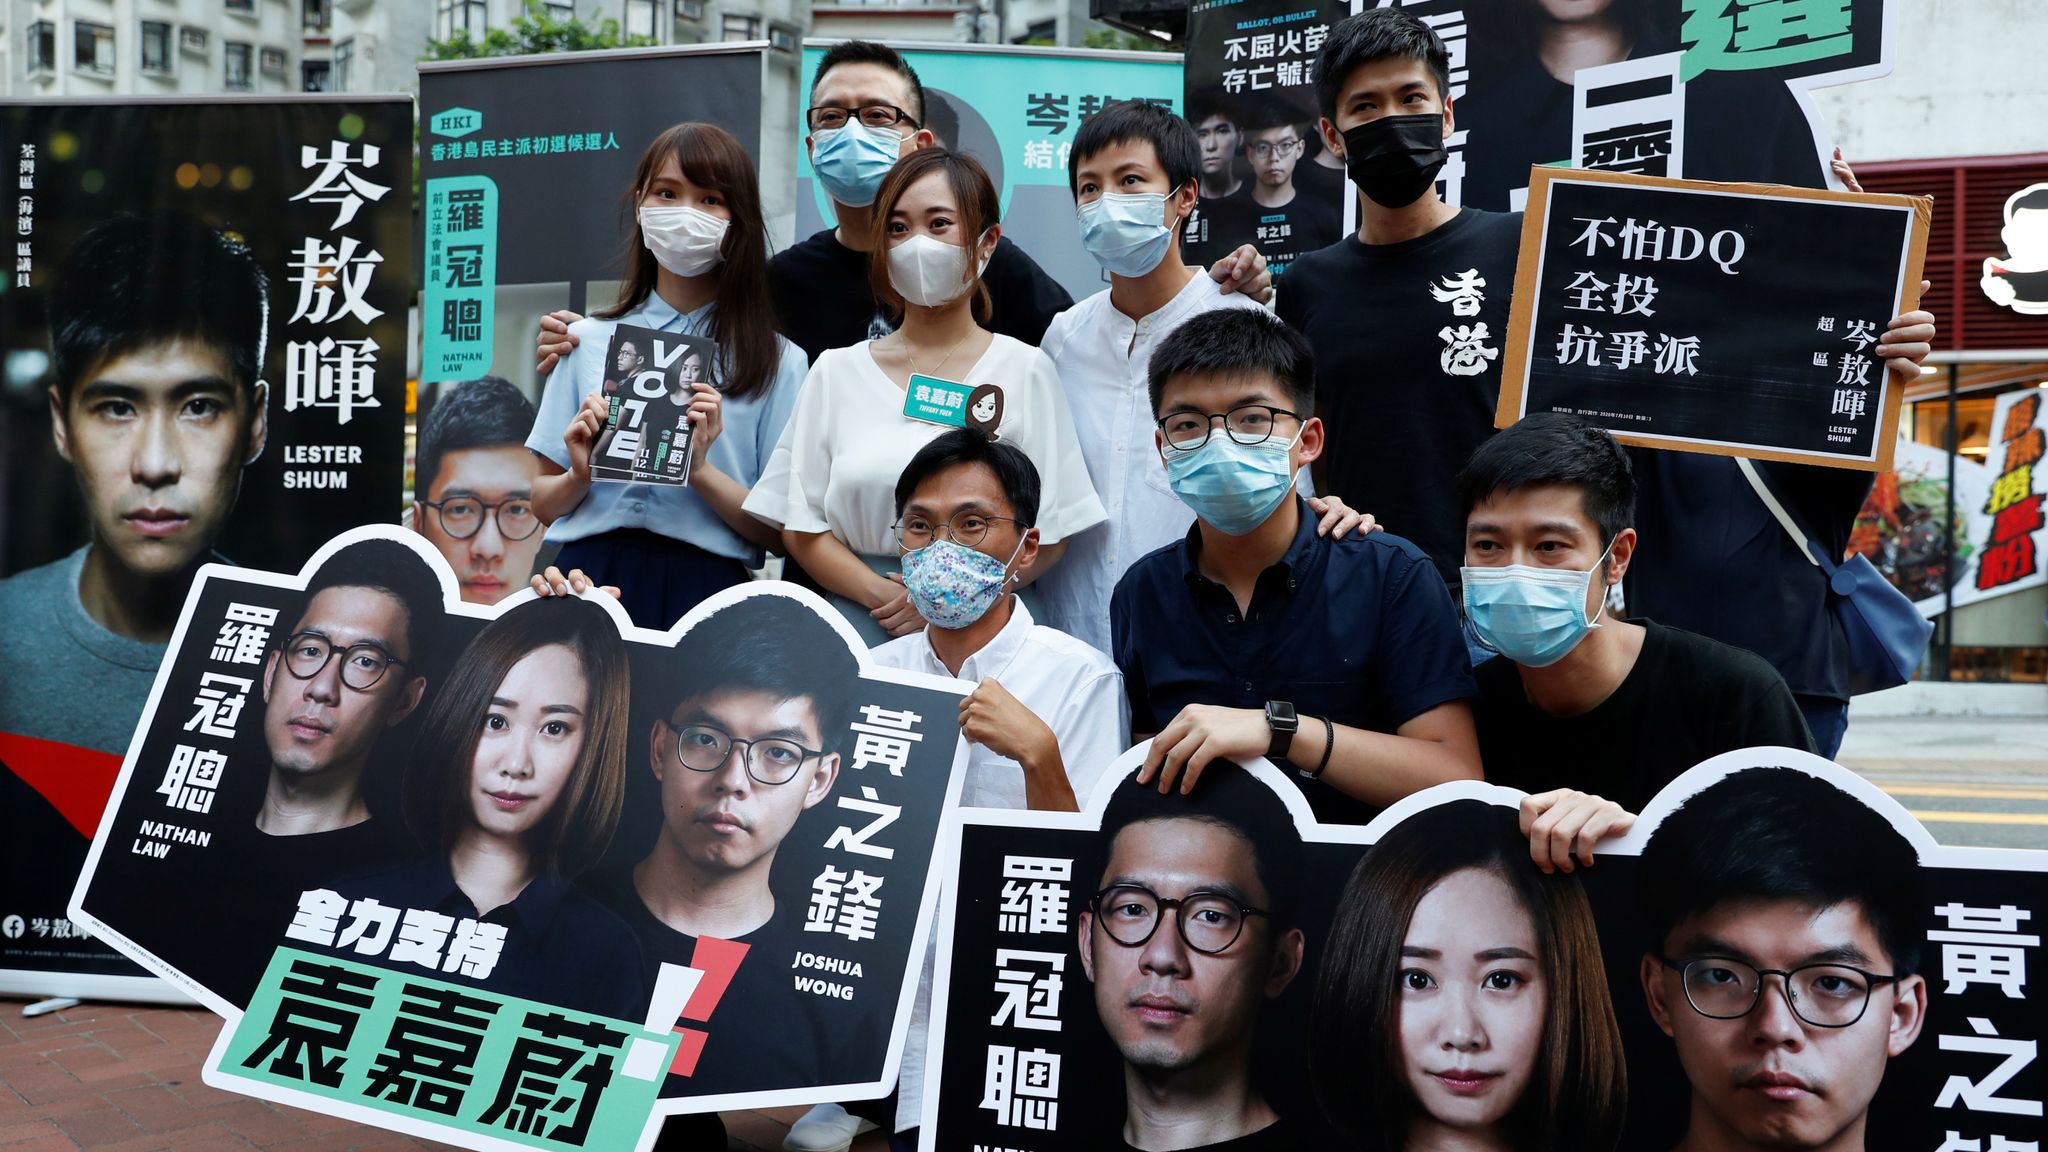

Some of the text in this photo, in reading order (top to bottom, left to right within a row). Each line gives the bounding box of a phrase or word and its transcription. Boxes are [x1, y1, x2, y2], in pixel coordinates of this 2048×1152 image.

[1285, 10, 1317, 22] BULLET
[440, 115, 473, 131] HKI
[431, 132, 620, 162] 香港島民主派初選候選人
[430, 192, 444, 283] 前立法會議員
[1569, 216, 1746, 275] 不怕DQ
[441, 188, 485, 343] 羅冠聰
[284, 140, 391, 426] 岑敖暉
[1563, 270, 1659, 318] 全投
[1429, 268, 1499, 376] 香港
[442, 352, 483, 363] NATHAN
[442, 363, 463, 373] LAW
[1831, 319, 1878, 421] 岑敖暉
[914, 384, 964, 409] 袁嘉蔚
[1827, 434, 1852, 444] SHUM
[1828, 425, 1858, 436] LESTER
[284, 445, 363, 464] LESTER
[283, 470, 348, 489] SHUM
[157, 602, 281, 814] 羅冠聰
[138, 819, 212, 848] NATHAN
[803, 703, 924, 942] 黃之鋒
[131, 840, 172, 860] LAW
[284, 888, 508, 981] 全力支持
[792, 949, 864, 979] JOSHUA
[793, 974, 856, 1002] WONG
[978, 855, 1075, 1131] 羅冠聰
[1926, 902, 2045, 1152] 黃之
